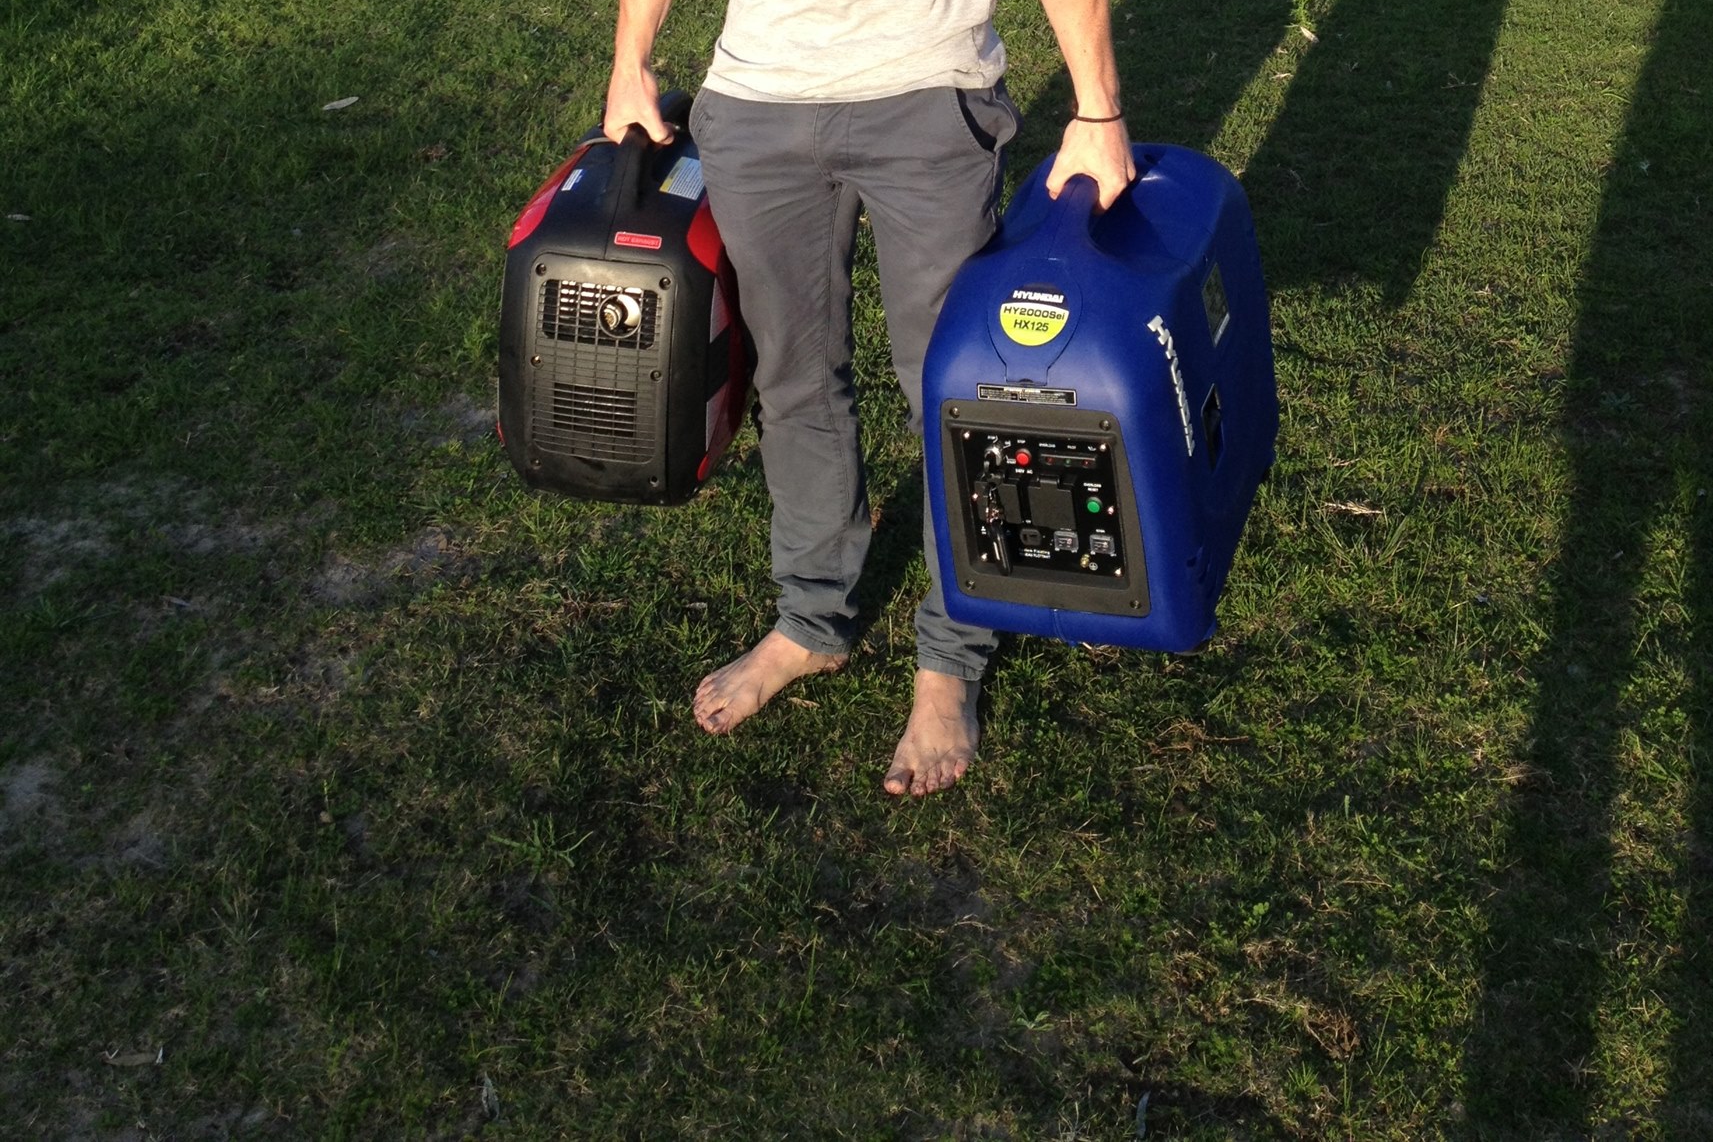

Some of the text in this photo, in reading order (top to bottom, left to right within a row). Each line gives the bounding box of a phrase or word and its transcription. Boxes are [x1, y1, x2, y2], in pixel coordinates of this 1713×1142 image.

[1012, 289, 1065, 304] HYUNDAI
[1003, 305, 1066, 321] HY2000Sei
[1013, 318, 1050, 332] HX125
